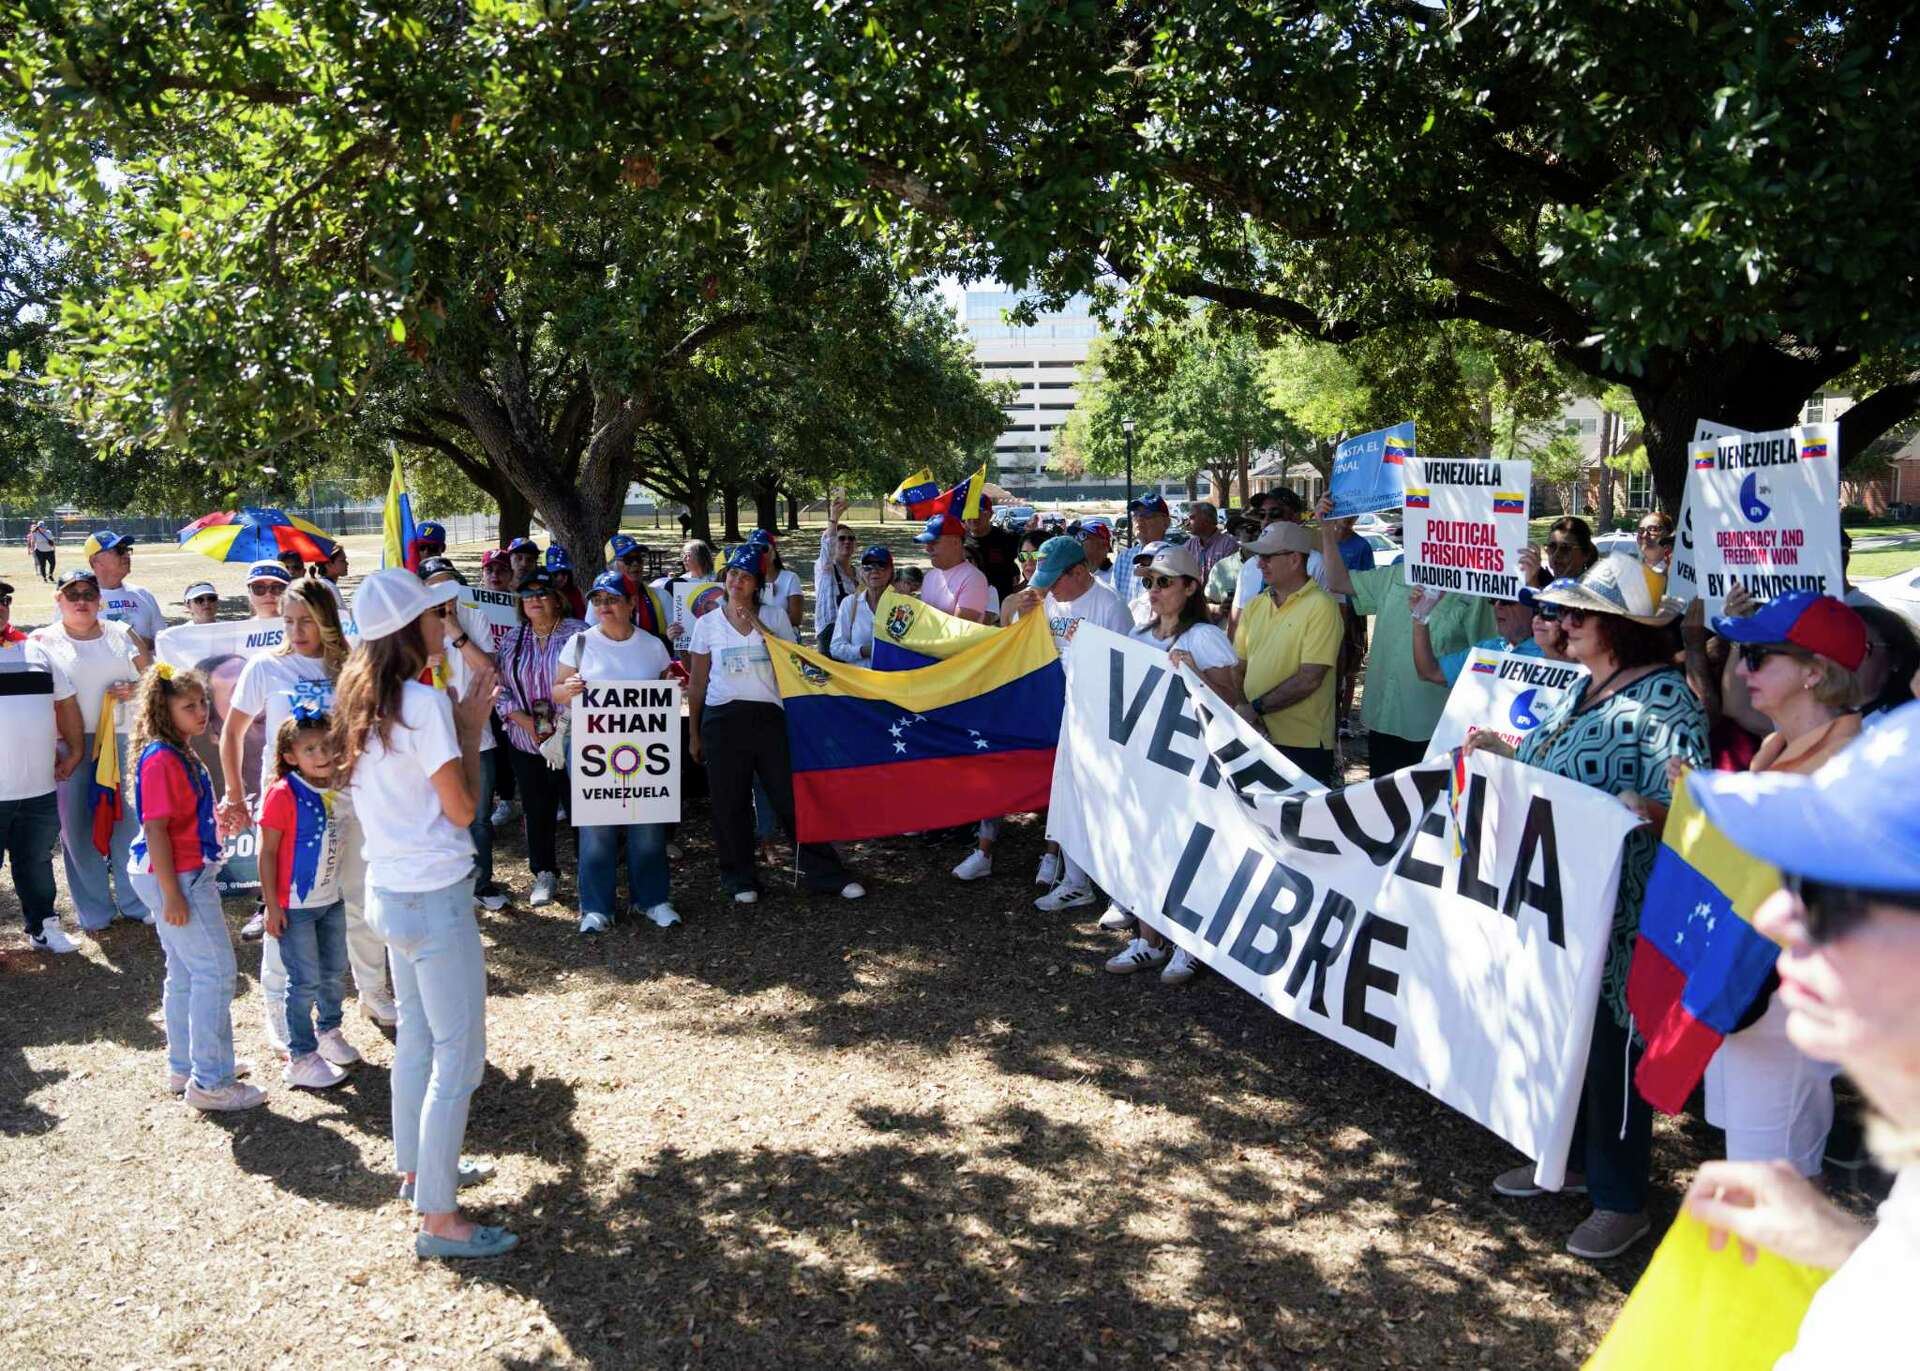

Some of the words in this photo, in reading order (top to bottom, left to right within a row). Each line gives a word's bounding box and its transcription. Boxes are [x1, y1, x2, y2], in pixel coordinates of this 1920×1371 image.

[1367, 441, 1380, 453] EL
[1717, 438, 1798, 470] VENEZUELA
[1425, 462, 1502, 487] VENEZUELA
[1427, 519, 1498, 547] POLITICAL
[1716, 529, 1777, 548] DEMOCRACY
[1781, 528, 1804, 546] AND
[1421, 542, 1505, 572] PRISIONERS
[1724, 549, 1768, 565] FREEDOM
[1771, 548, 1799, 565] WON
[1411, 564, 1462, 589] MADURO
[1466, 571, 1519, 597] TYRANT
[1707, 573, 1725, 597] BY
[582, 687, 673, 708] KARIM
[587, 713, 667, 734] KHAN
[580, 742, 671, 778] SOS
[582, 786, 670, 800] VENEZUELA
[1161, 820, 1409, 1049] LIBRE
